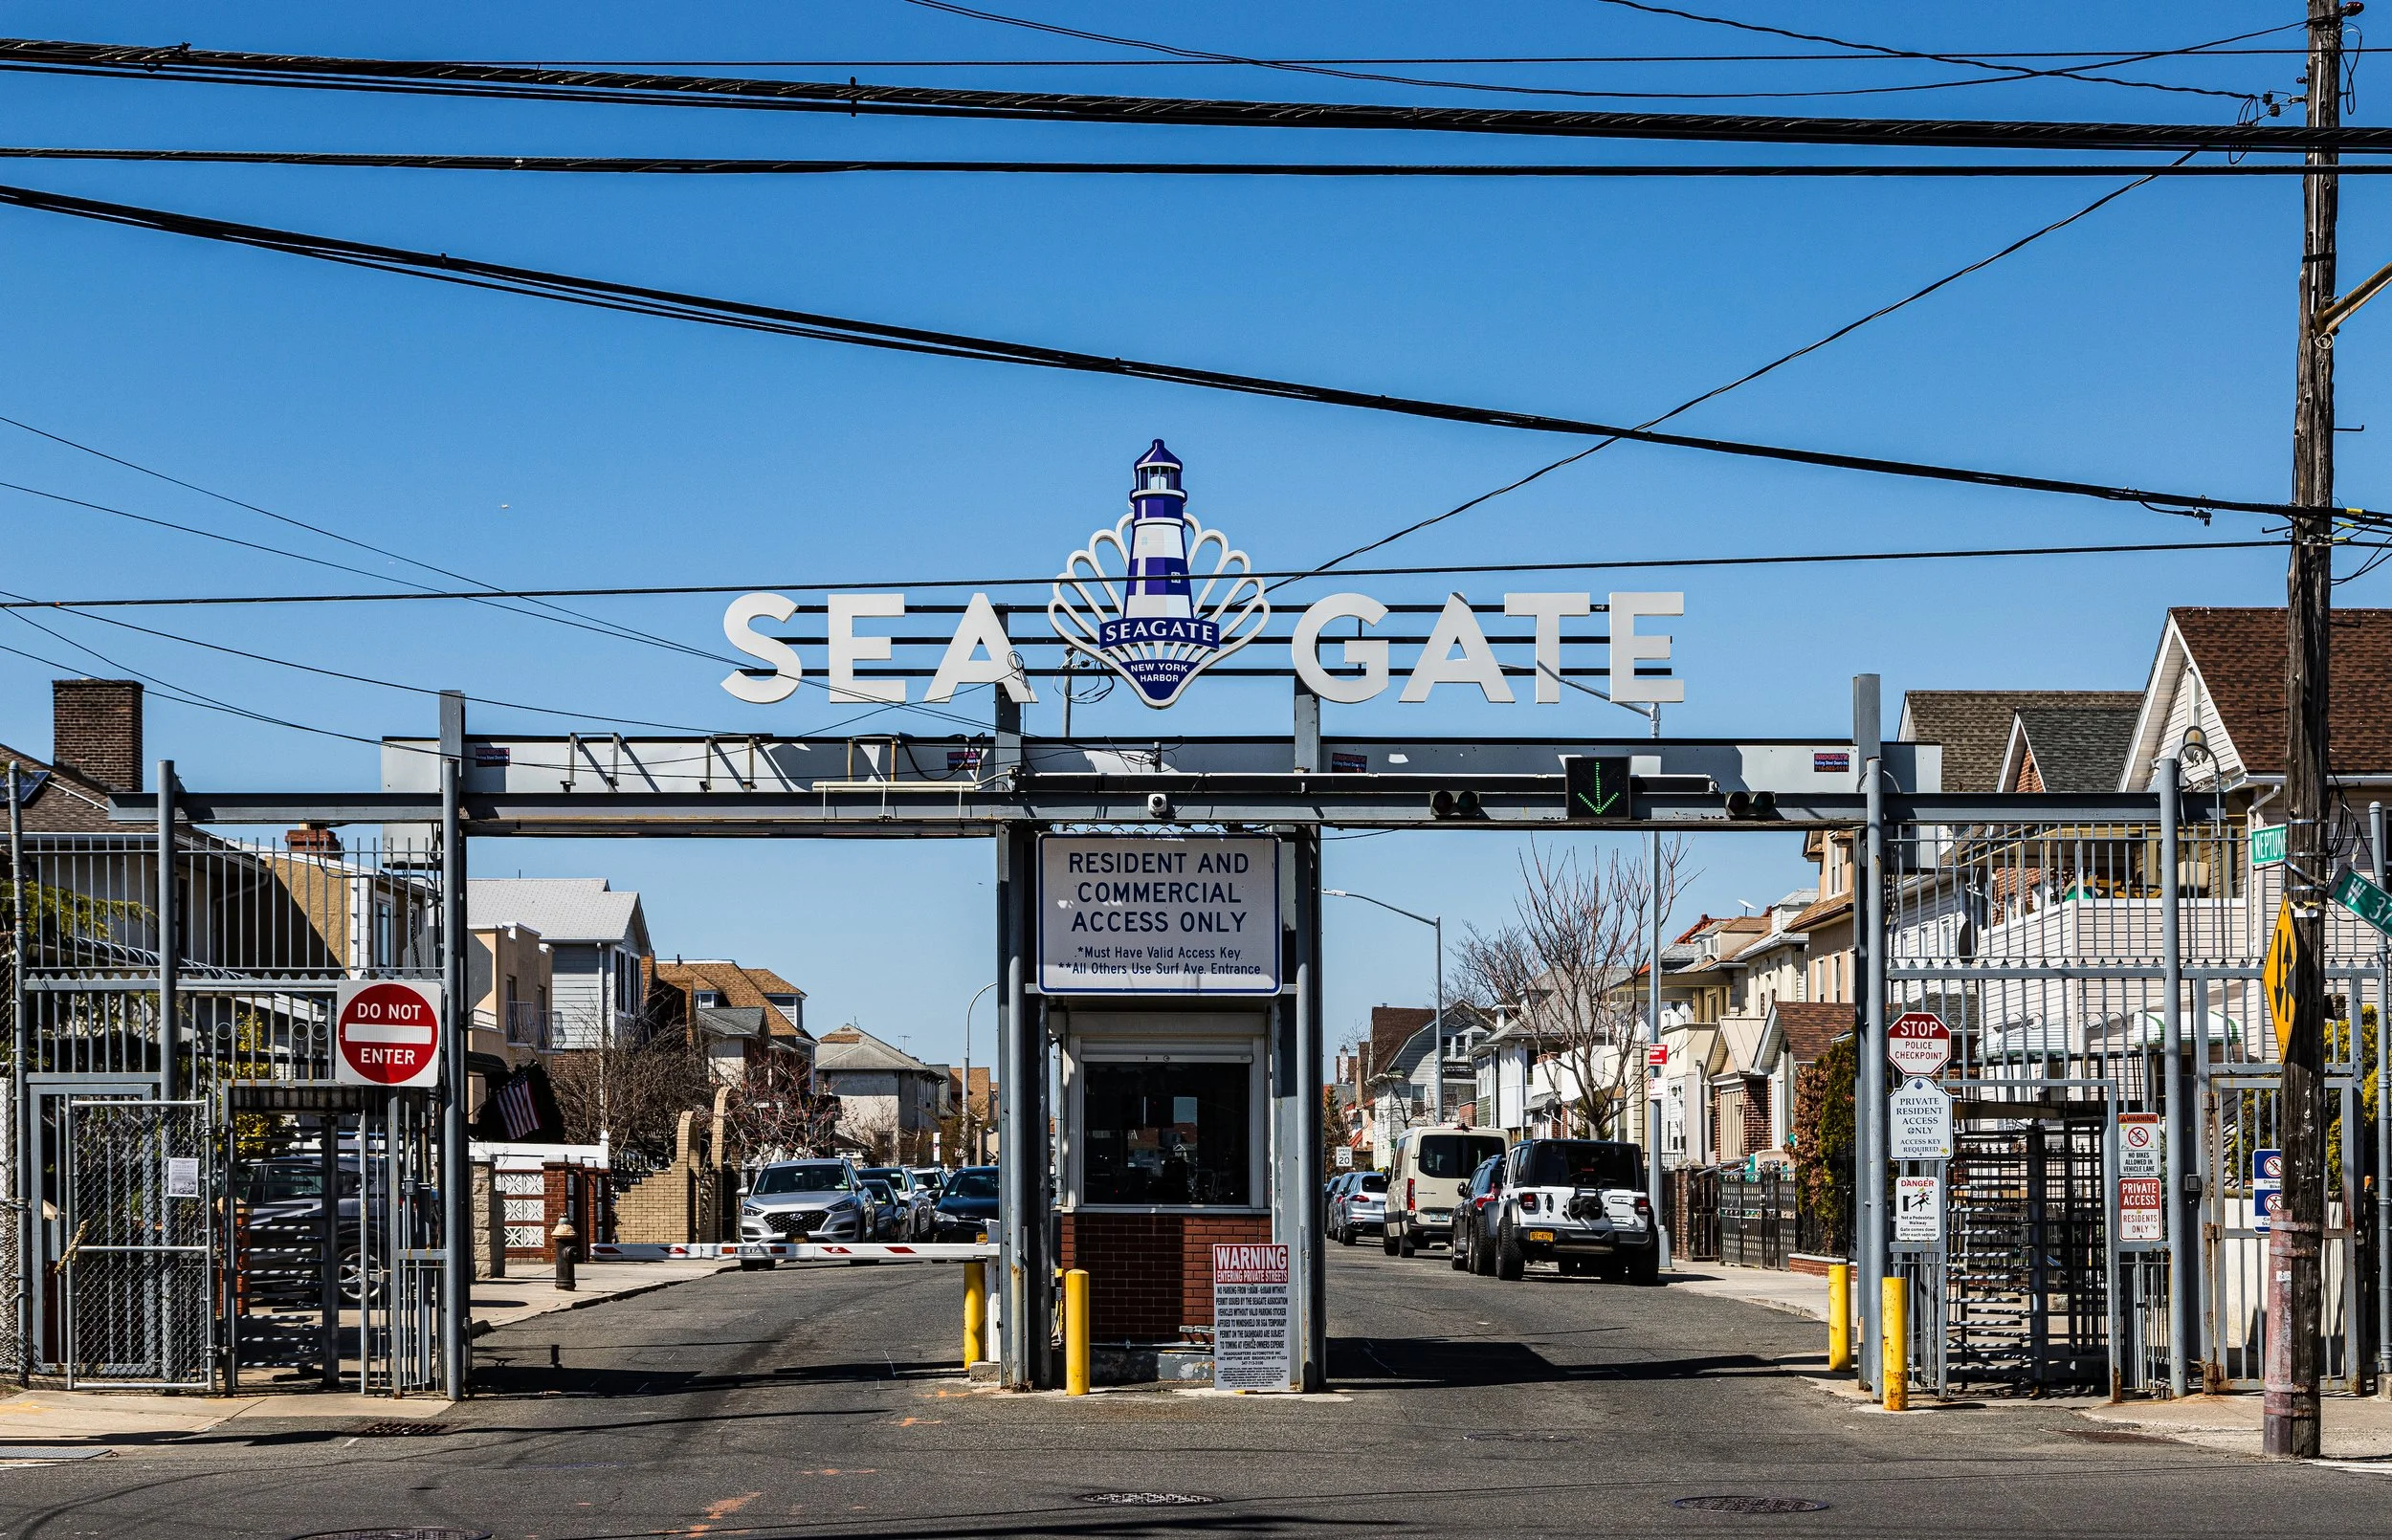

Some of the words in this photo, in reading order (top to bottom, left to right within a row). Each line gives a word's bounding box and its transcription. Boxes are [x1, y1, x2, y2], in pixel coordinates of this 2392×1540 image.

[1105, 621, 1213, 642] SEAGATE
[720, 592, 1037, 704] SEA
[1291, 592, 1685, 704] GATE
[1131, 663, 1155, 672] NEW
[1158, 663, 1188, 672] YORK
[1141, 674, 1179, 682] HARBOR
[2254, 829, 2287, 859] NEPTUNE
[1069, 852, 1187, 873] RESIDENT
[1197, 852, 1249, 873] AND
[1077, 882, 1242, 903] COMMERCIAL
[2344, 878, 2368, 905] W
[1071, 911, 1169, 933] ACCESS
[1180, 911, 1248, 933] ONLY
[1115, 946, 1142, 958] Have
[1147, 946, 1173, 958] Valid
[1178, 946, 1215, 958] Access
[1092, 963, 1127, 975] Others
[1132, 963, 1152, 975] Use
[1156, 963, 1180, 975] Surf
[1184, 963, 1207, 975] Ave.
[1211, 963, 1261, 975] Entrance
[357, 1002, 381, 1019] DO
[388, 1004, 421, 1020] NOT
[1900, 1021, 1938, 1036] STOP
[1905, 1041, 1933, 1049] POLICE
[361, 1048, 415, 1065] ENTER
[1895, 1051, 1942, 1060] CHECKPOINT
[2122, 1183, 2157, 1194] PRIVATE
[2124, 1195, 2156, 1206] ACCESS
[1216, 1247, 1286, 1269] WARNING
[1218, 1270, 1242, 1282] ENTERING
[1244, 1270, 1264, 1282] PRIVATE
[1265, 1270, 1287, 1282] STREETS
